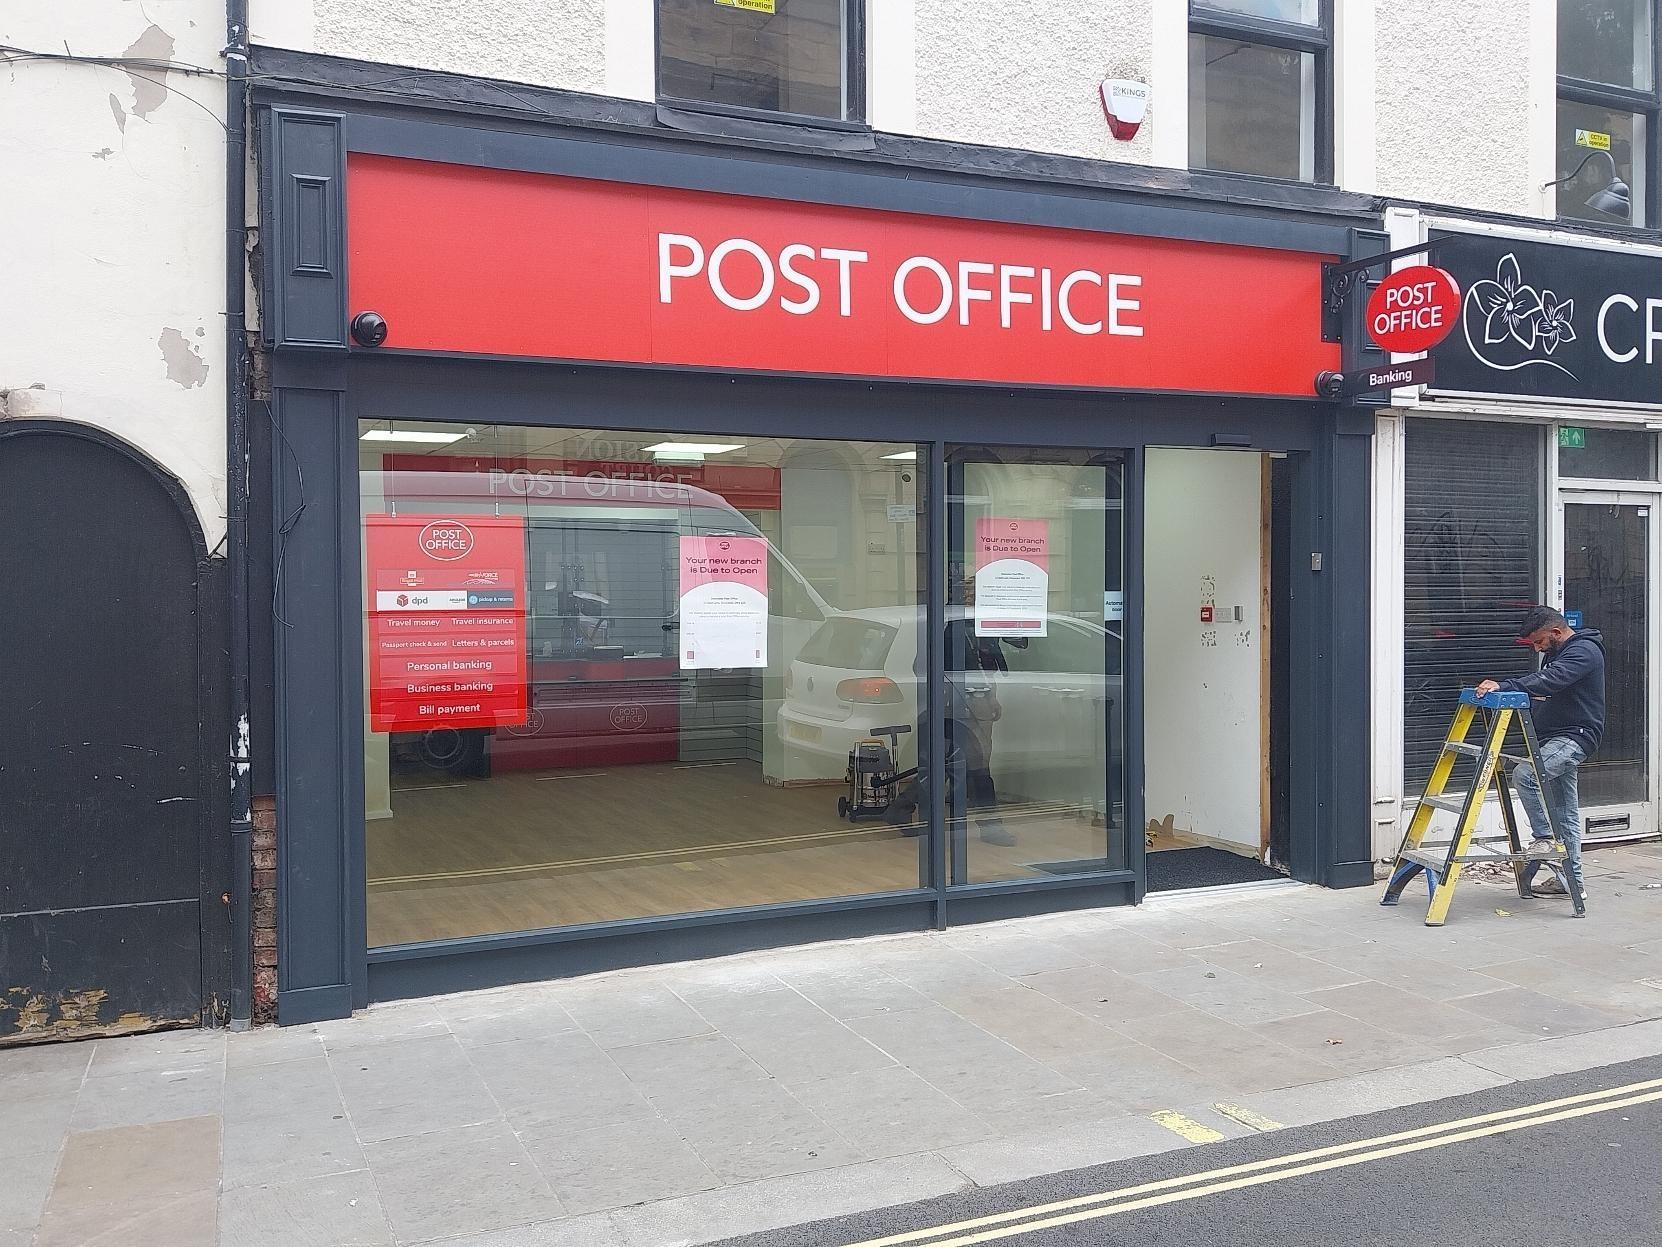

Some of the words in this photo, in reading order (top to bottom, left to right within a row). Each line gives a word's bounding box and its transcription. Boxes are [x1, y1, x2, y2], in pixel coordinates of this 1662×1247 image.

[1121, 87, 1146, 98] KINGS
[657, 232, 869, 318] POST
[892, 255, 1146, 338] OFFICE
[1386, 281, 1437, 309] POST
[1374, 305, 1443, 335] OFFICE
[1369, 369, 1413, 386] Banking
[488, 468, 574, 496] POST
[583, 470, 694, 499] OFFICE
[432, 529, 463, 540] POST
[426, 539, 467, 550] OFFICE
[1018, 536, 1045, 545] branch
[1020, 545, 1041, 553] Open
[730, 557, 762, 565] branch
[732, 567, 758, 575] Open
[411, 596, 429, 606] dpd
[387, 619, 412, 627] Travel
[413, 619, 441, 627] money
[451, 617, 475, 625] Travel
[476, 617, 514, 625] insurance
[452, 639, 479, 647] Letters
[487, 638, 515, 647] parcels
[407, 661, 450, 671] Personal
[452, 660, 492, 671] banking
[407, 683, 452, 693] Business
[454, 681, 493, 692] banking
[419, 704, 435, 715] Bill
[437, 704, 481, 716] payment
[619, 707, 640, 716] POST
[614, 714, 643, 724] OFFICE
